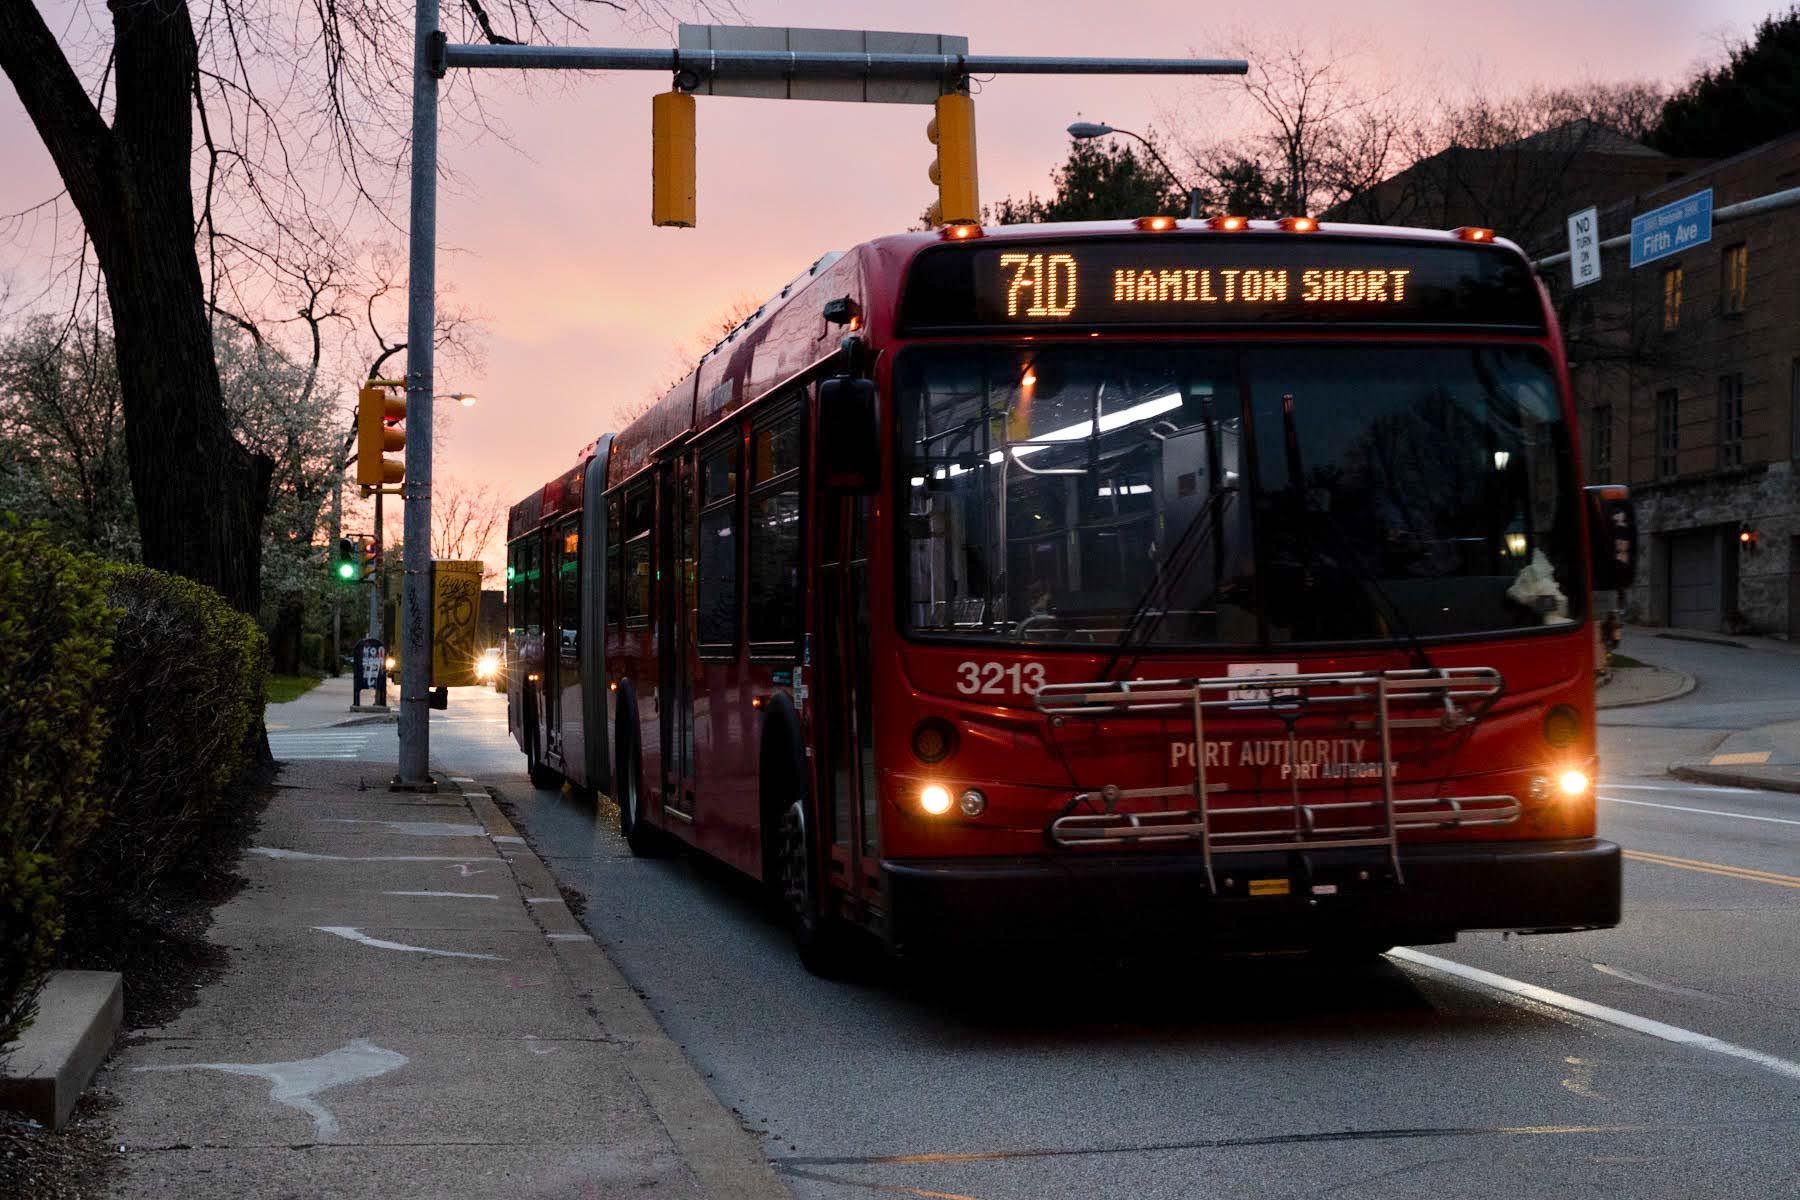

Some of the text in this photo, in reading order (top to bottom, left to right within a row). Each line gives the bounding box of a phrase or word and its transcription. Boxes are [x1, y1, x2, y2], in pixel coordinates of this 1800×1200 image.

[1576, 217, 1590, 235] NO
[1643, 223, 1698, 257] Fifth Ave
[1000, 254, 1410, 317] 71D HAMILTON SHORT
[1580, 264, 1593, 277] RED
[956, 661, 1047, 695] 3213
[1239, 739, 1366, 766] AUTHORITY
